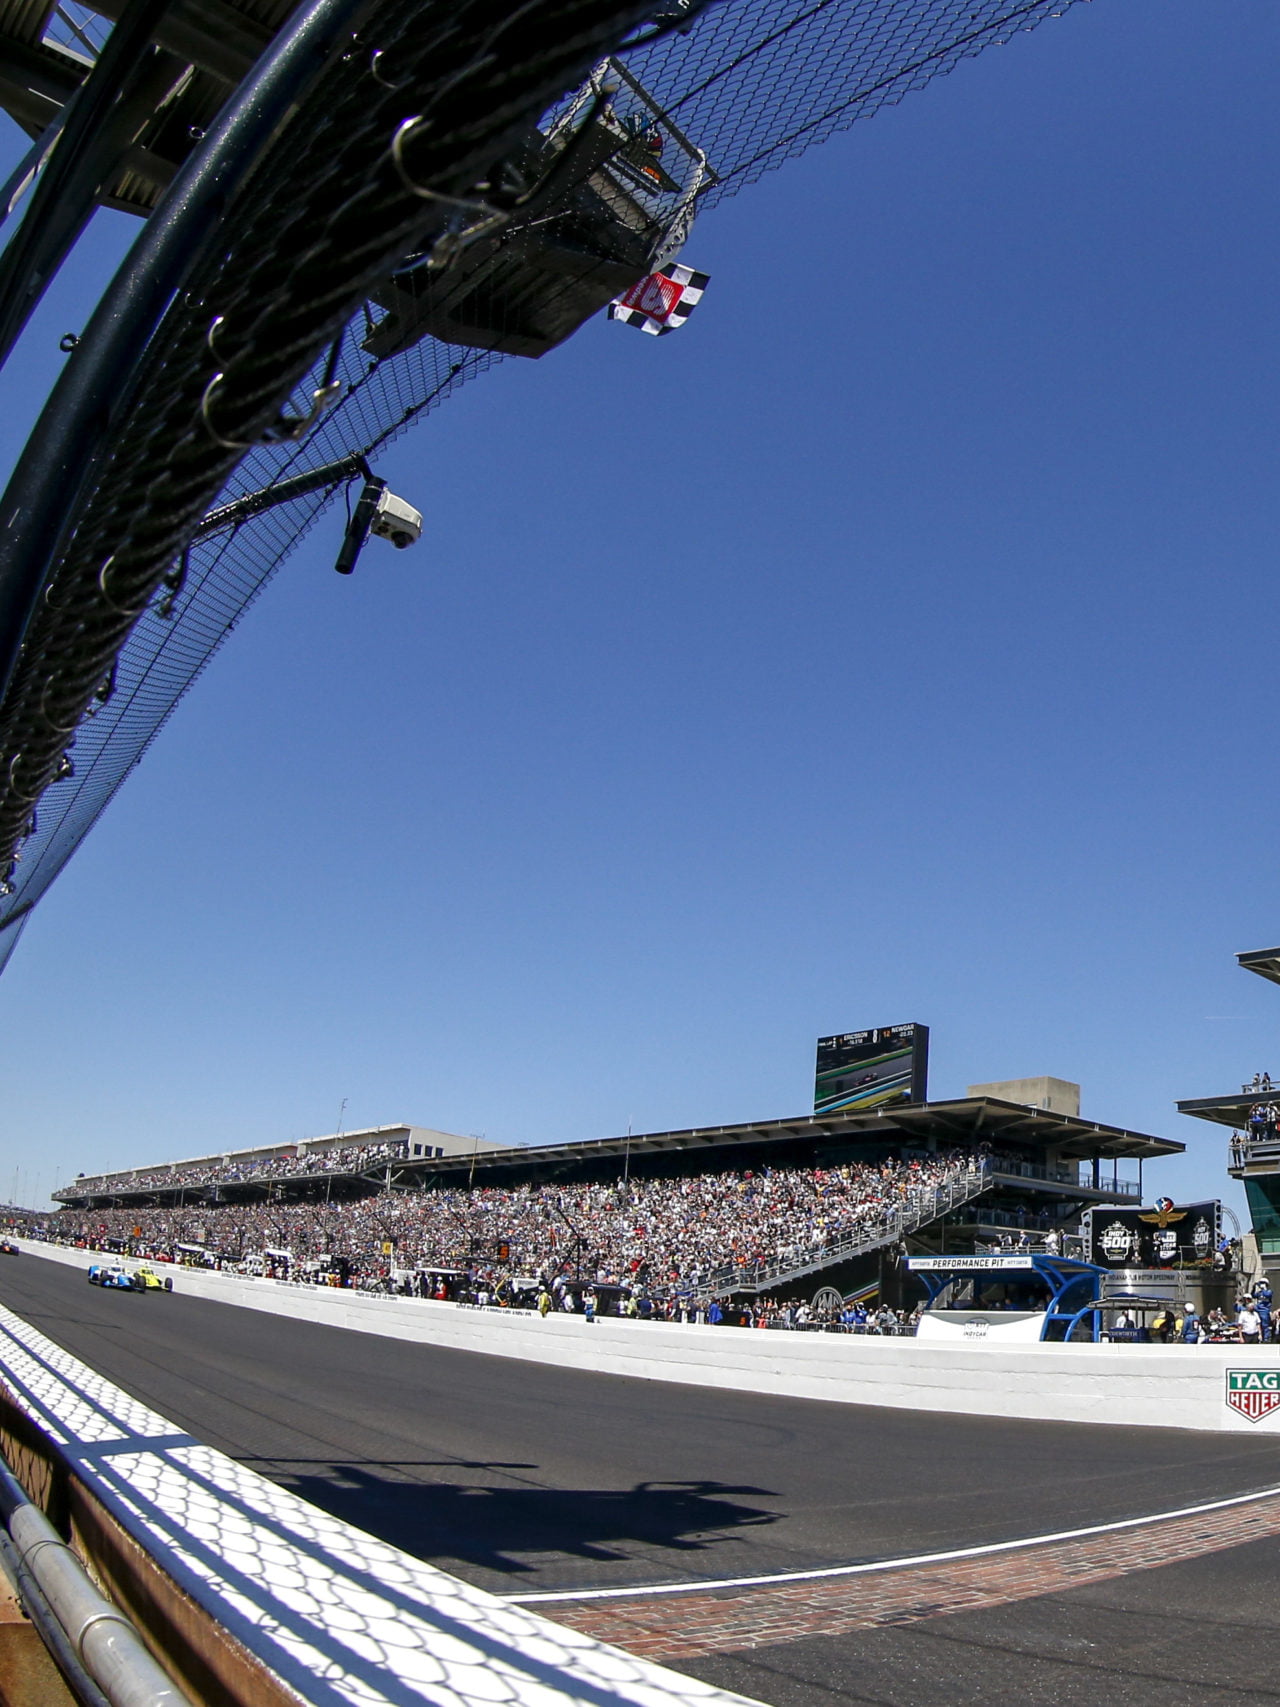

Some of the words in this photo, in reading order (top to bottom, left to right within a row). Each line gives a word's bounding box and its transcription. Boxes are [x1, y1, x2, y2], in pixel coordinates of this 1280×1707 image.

[1102, 1236, 1131, 1249] 500
[1194, 1232, 1209, 1245] 500
[932, 1260, 989, 1268] PERFORMANCE
[991, 1258, 1005, 1267] PIT
[1231, 1373, 1278, 1389] TAG
[1230, 1393, 1279, 1417] HEUER
